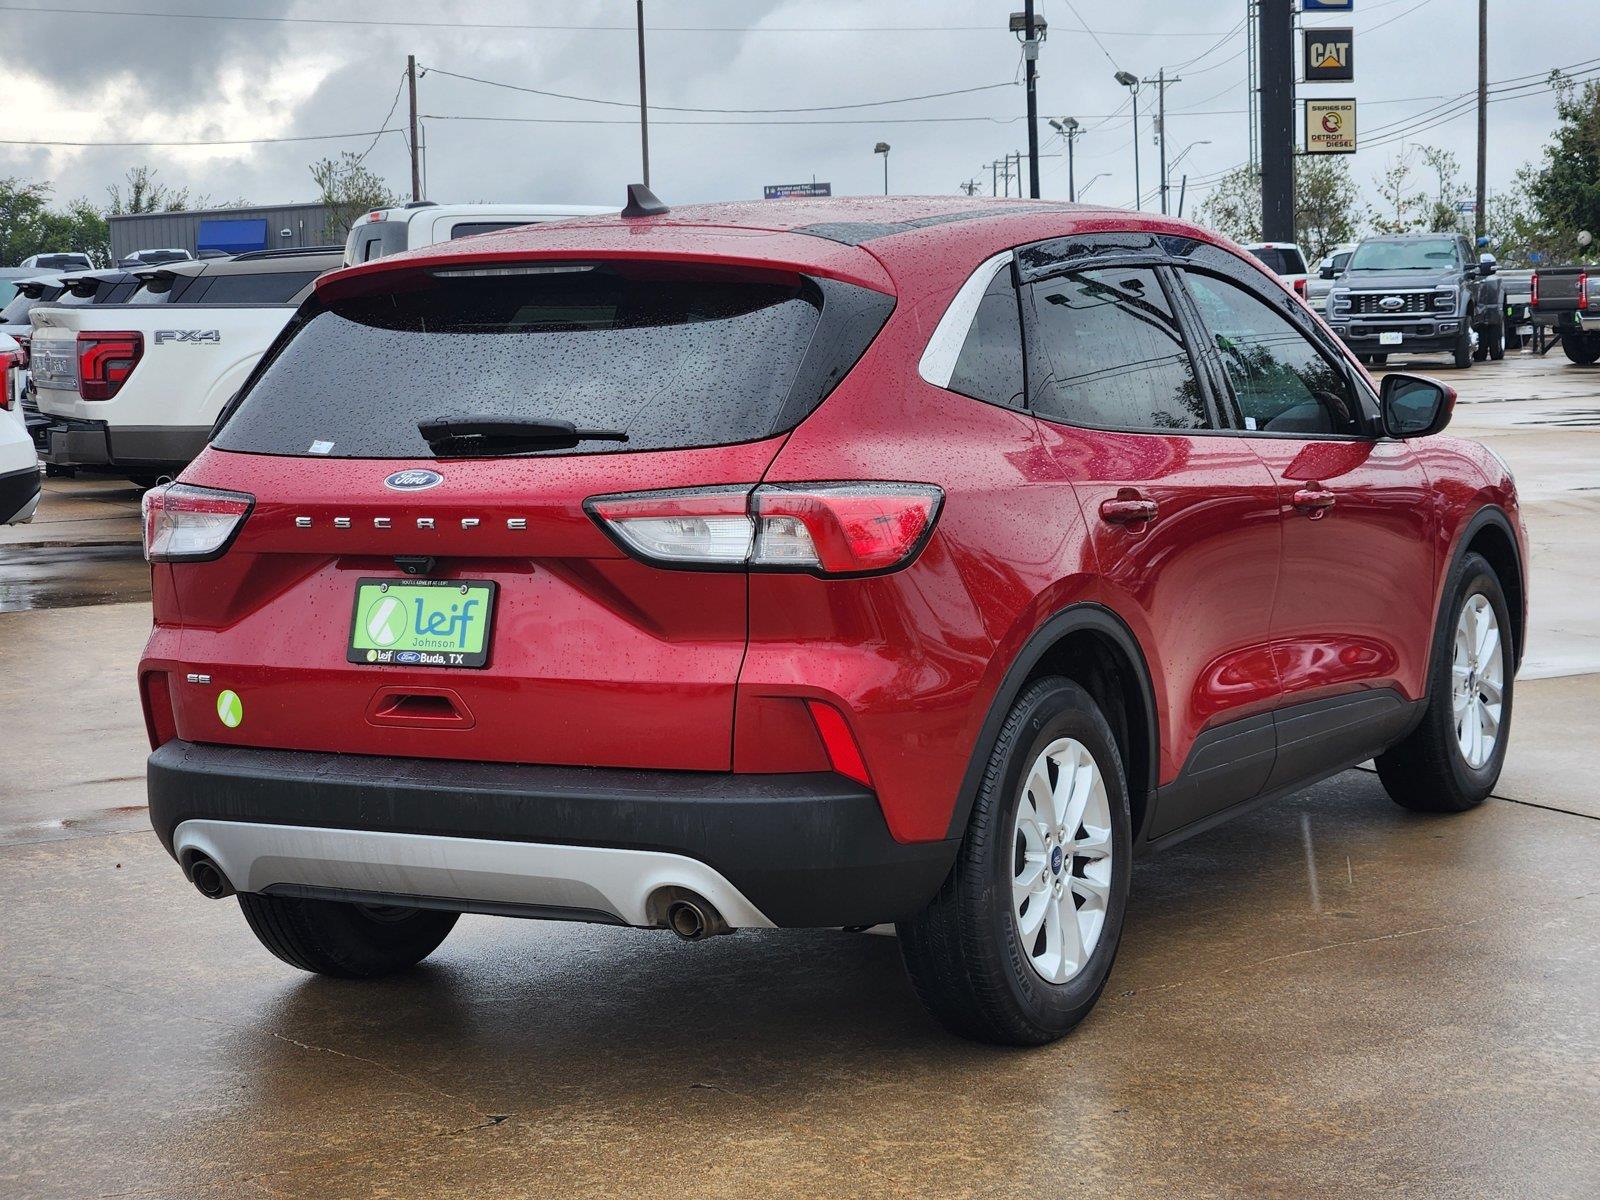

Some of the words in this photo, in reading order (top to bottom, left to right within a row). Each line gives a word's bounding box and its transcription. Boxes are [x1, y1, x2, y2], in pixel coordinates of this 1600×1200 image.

[1310, 42, 1349, 68] CAT
[154, 329, 220, 345] FX4
[295, 516, 527, 530] ESCAPE
[414, 597, 479, 648] leif
[412, 637, 455, 648] Johnson
[377, 650, 393, 662] leif
[420, 653, 446, 664] Buda,
[449, 654, 464, 664] TX
[187, 673, 211, 684] SE
[1005, 916, 1031, 994] MICHELIN
